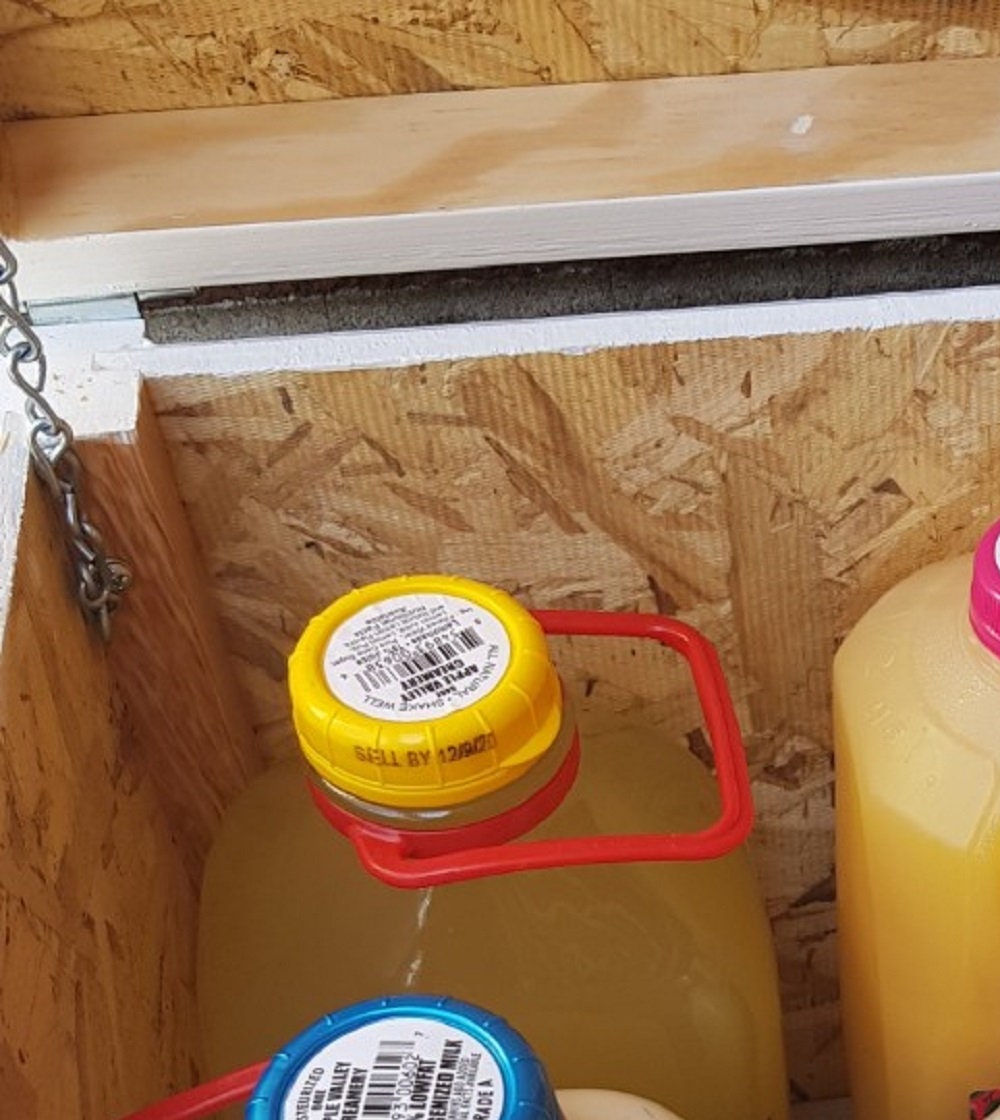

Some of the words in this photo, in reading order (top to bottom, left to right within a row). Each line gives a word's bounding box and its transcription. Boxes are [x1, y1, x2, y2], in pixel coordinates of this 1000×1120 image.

[399, 658, 464, 689] CREAMERY
[441, 664, 478, 684] APPLE
[399, 680, 441, 701] VALLEY
[352, 744, 401, 767] SELL
[407, 749, 431, 767] BY
[439, 1039, 462, 1069] MILK
[326, 1061, 350, 1100] VALLEY
[409, 1058, 436, 1108] LOWFAT
[477, 1078, 492, 1086] A
